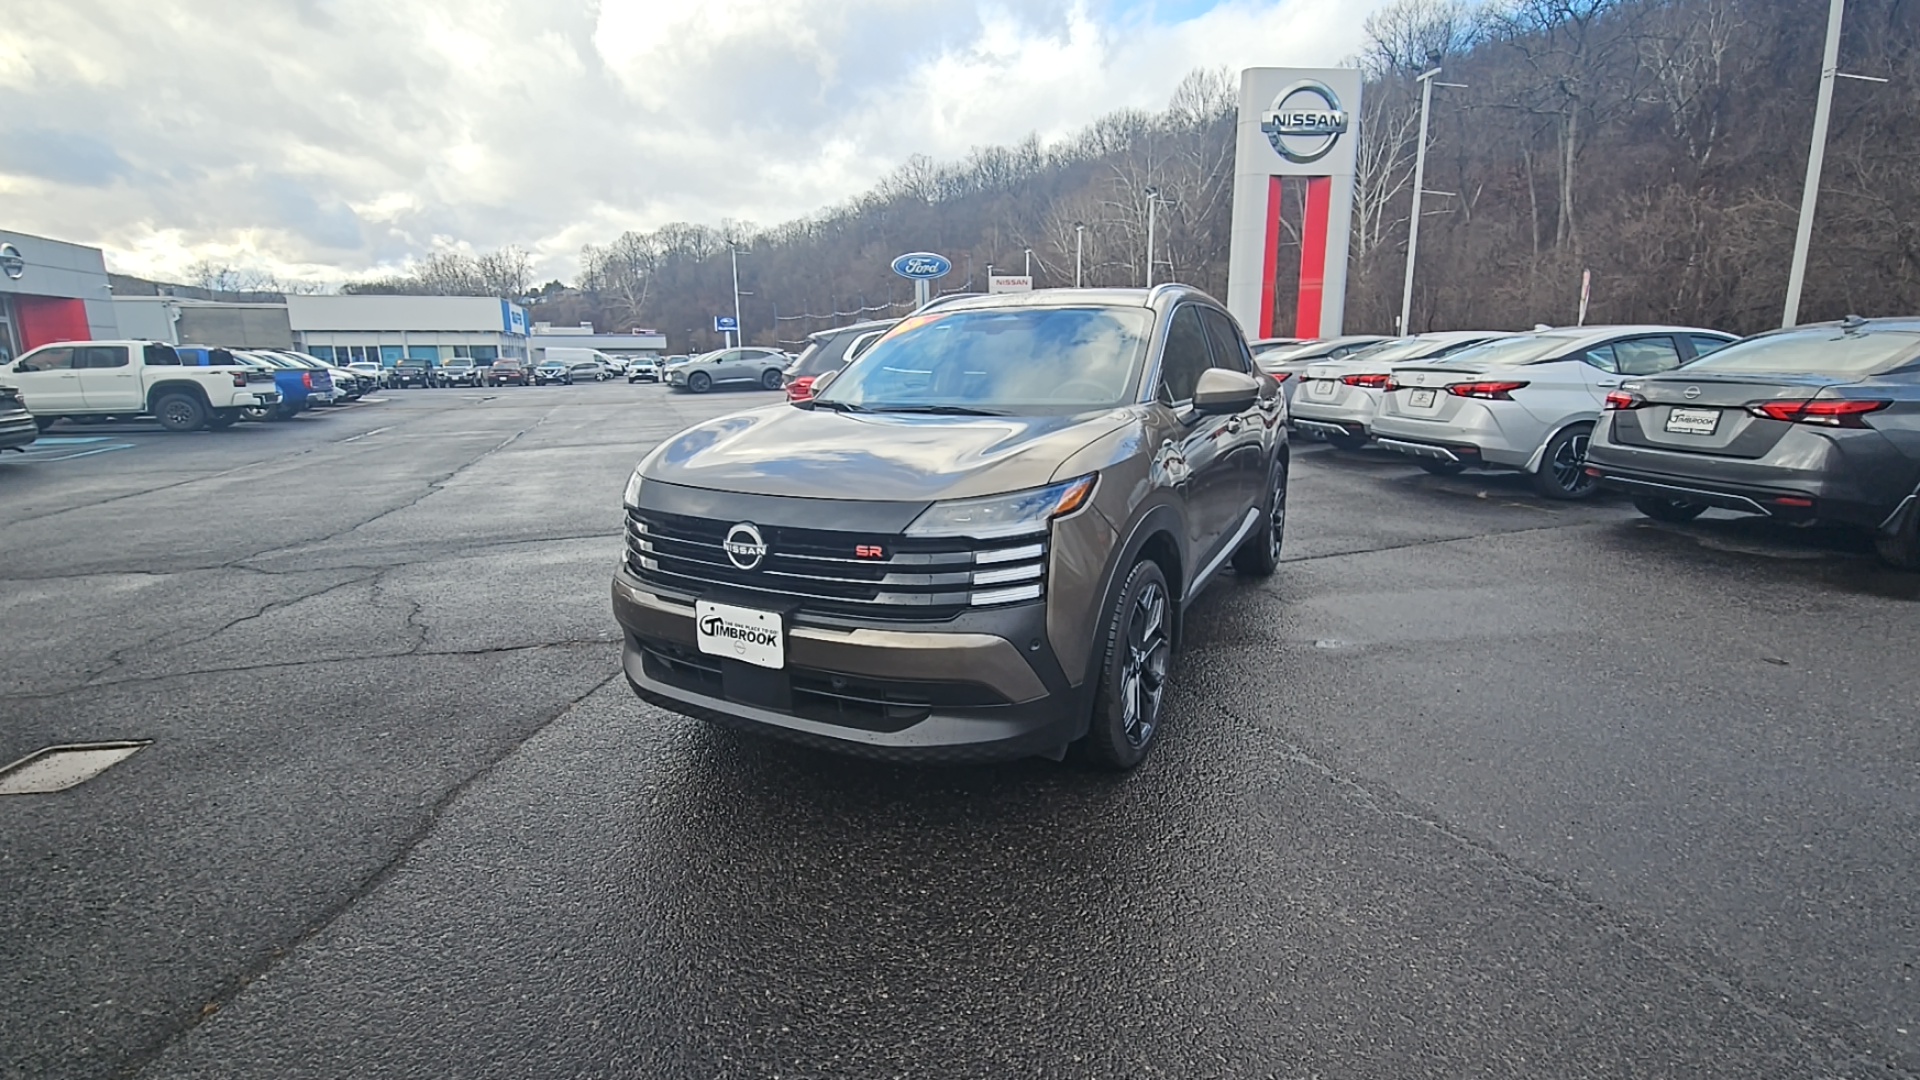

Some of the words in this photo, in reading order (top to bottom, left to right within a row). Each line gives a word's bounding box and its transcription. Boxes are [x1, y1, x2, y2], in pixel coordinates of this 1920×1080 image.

[1272, 114, 1341, 126] NISSAN
[905, 258, 939, 274] Ford
[723, 542, 767, 555] NISSAN
[855, 545, 883, 558] SR
[700, 615, 777, 647] TIMBROOK
